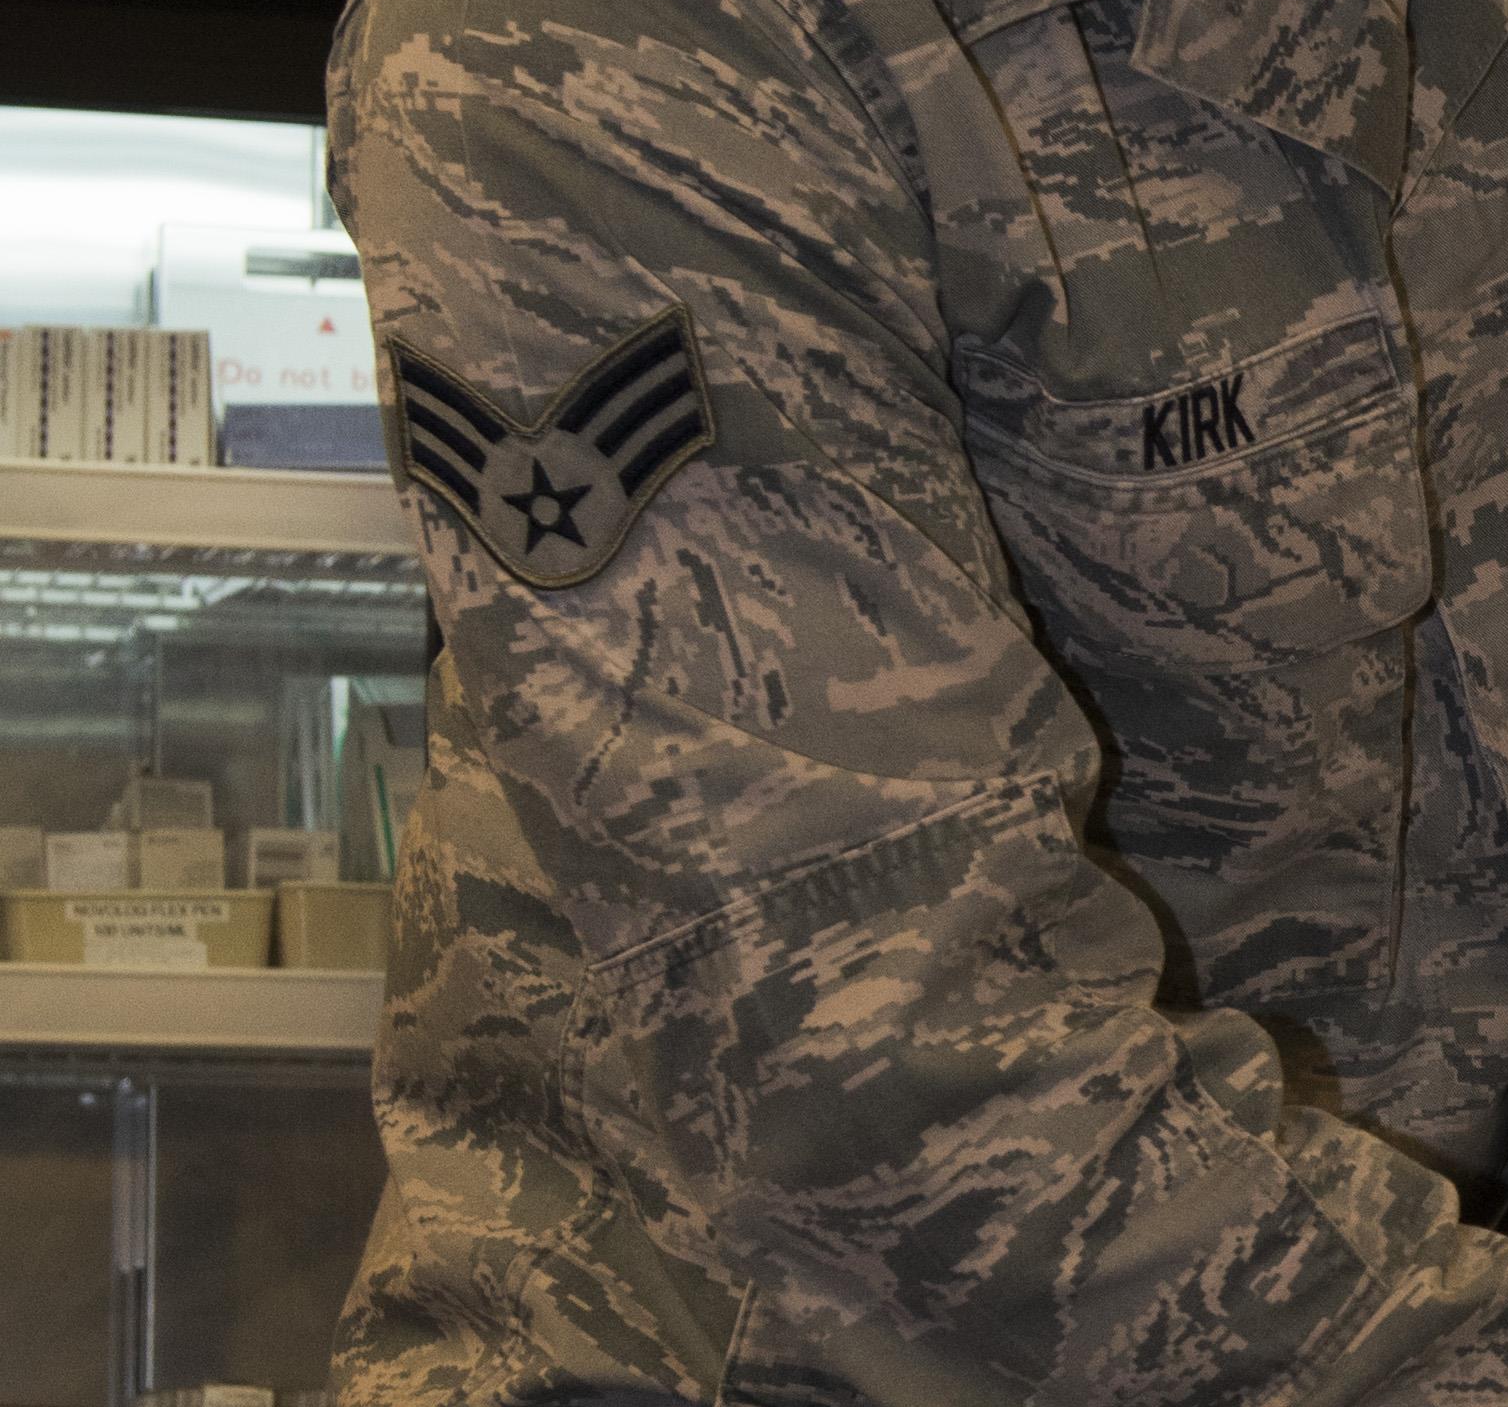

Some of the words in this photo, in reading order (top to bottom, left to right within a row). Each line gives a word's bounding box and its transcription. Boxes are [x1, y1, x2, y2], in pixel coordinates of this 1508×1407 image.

[218, 357, 262, 387] Do
[279, 366, 332, 390] not
[1142, 372, 1256, 471] KIRK
